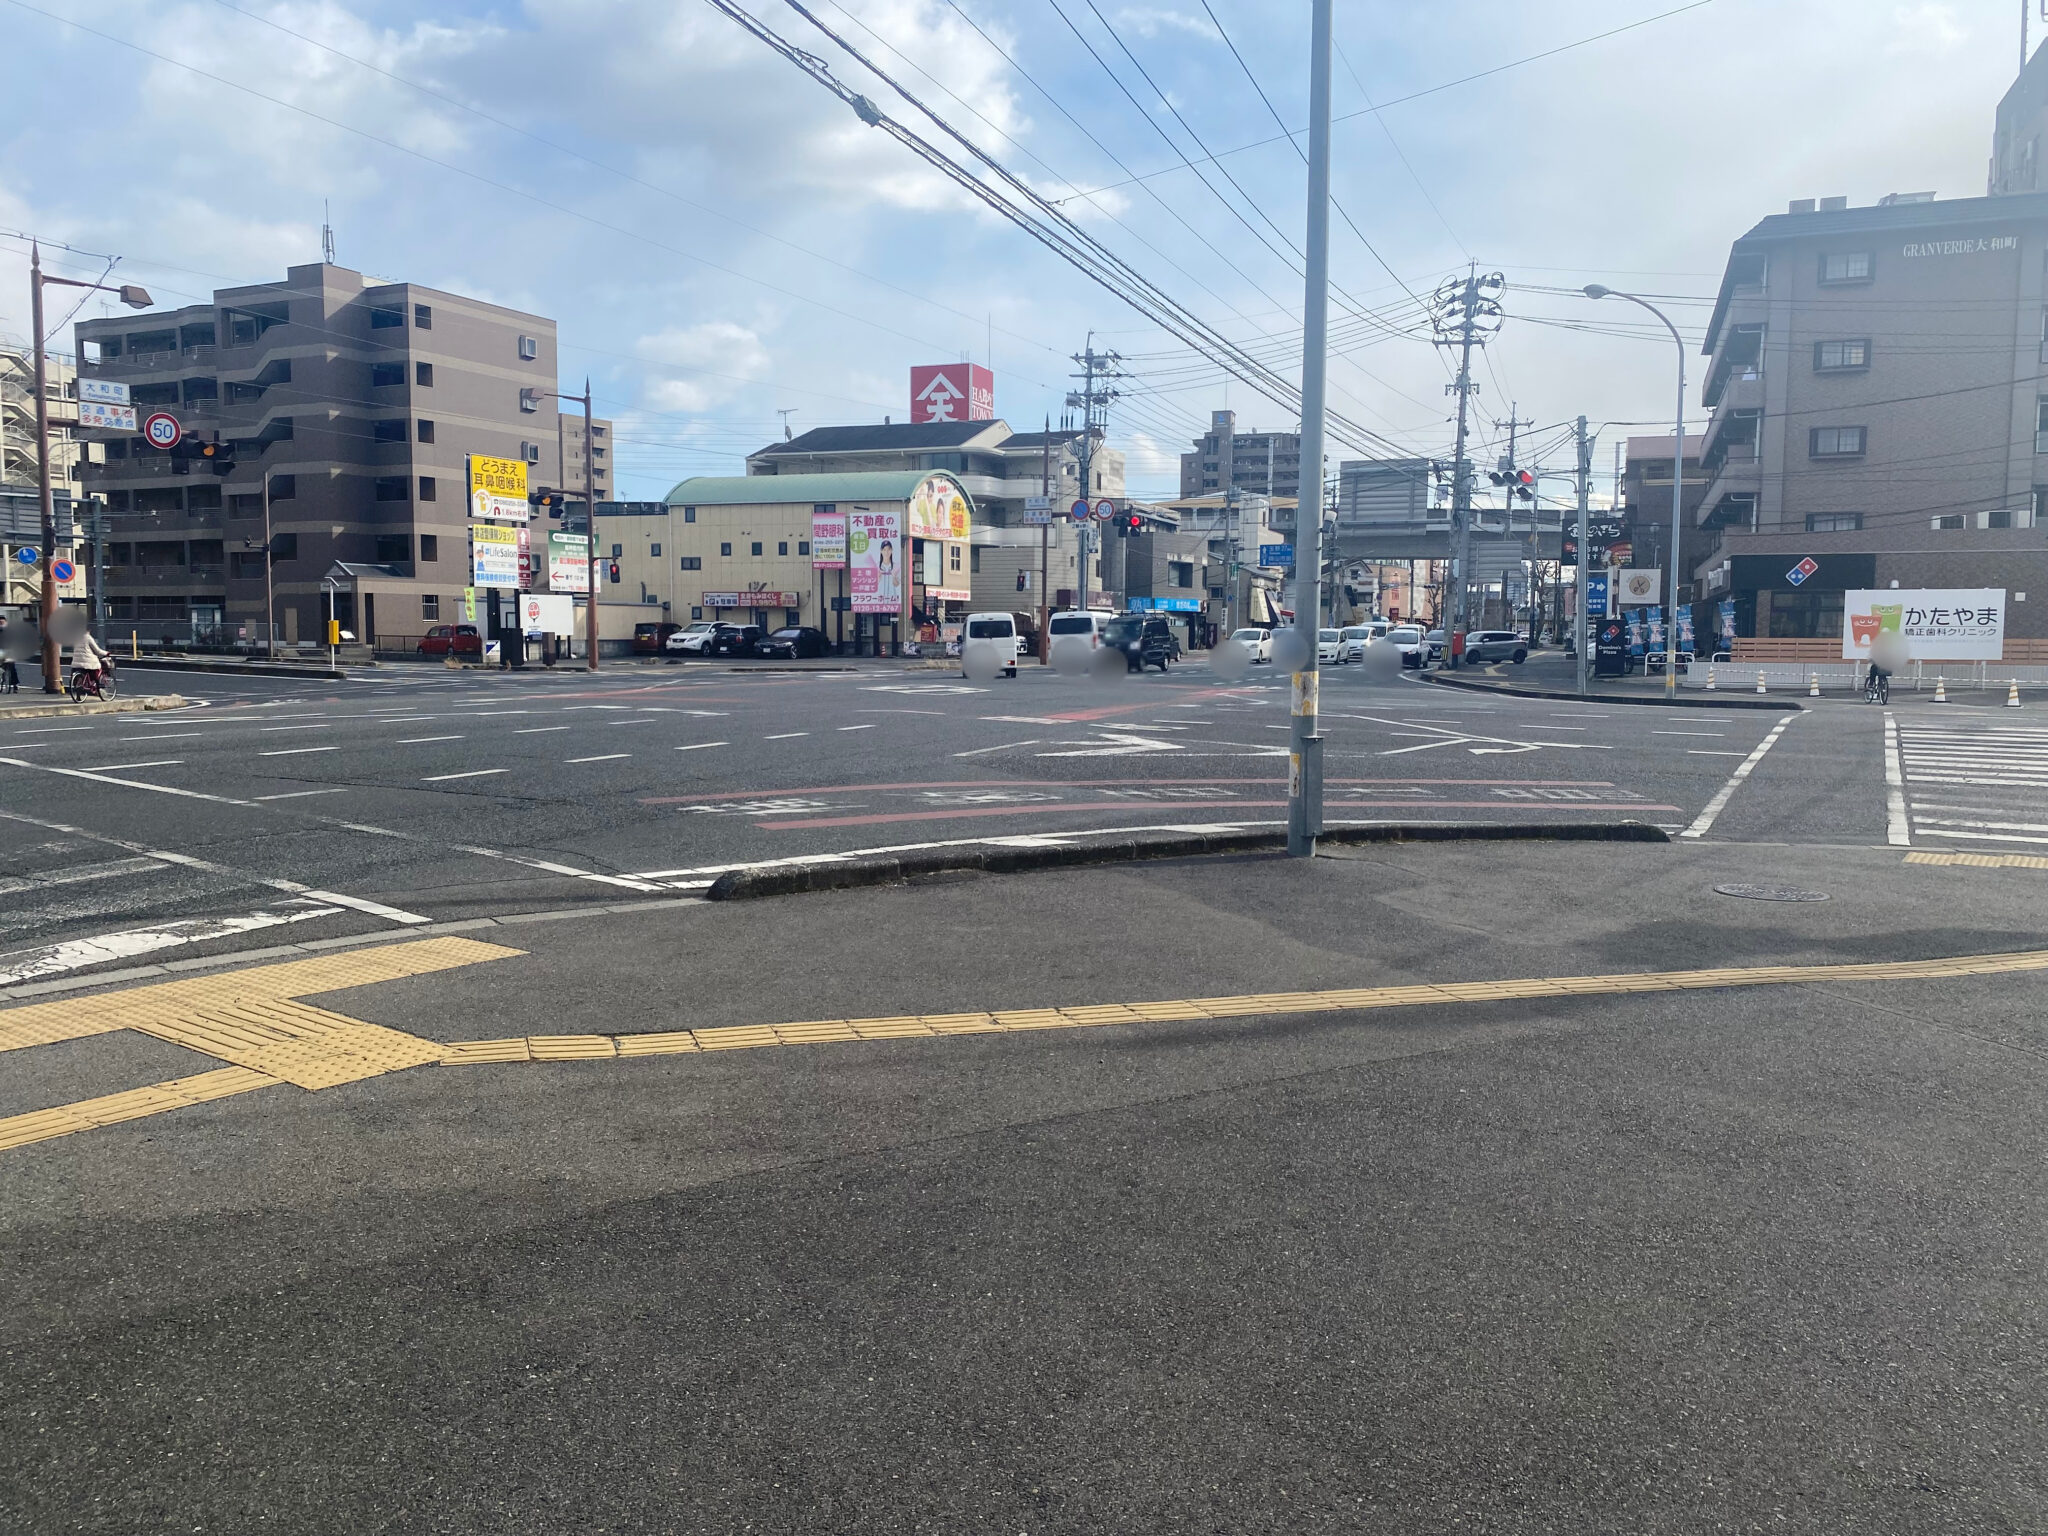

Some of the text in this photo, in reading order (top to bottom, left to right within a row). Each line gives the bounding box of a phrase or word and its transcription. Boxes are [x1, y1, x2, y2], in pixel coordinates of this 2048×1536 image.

[1903, 235, 2018, 257] GRANVERDE 大和町
[86, 383, 123, 396] 大和町
[972, 386, 992, 407] HAPPY
[81, 404, 133, 418] 交通事故
[972, 405, 992, 420] TOWN
[82, 414, 134, 428] 多発交差点
[153, 422, 173, 439] 50
[481, 459, 518, 477] どうまえ
[474, 472, 526, 492] 耳鼻咽喉科
[1099, 505, 1111, 515] 50
[852, 515, 895, 527] 不動産の
[867, 528, 898, 539] 買取は
[853, 540, 866, 551] 1日
[1572, 545, 1605, 553] おち帰り
[1905, 607, 1998, 626] かたやま
[1905, 628, 1997, 637] 矯正歯科クリニック
